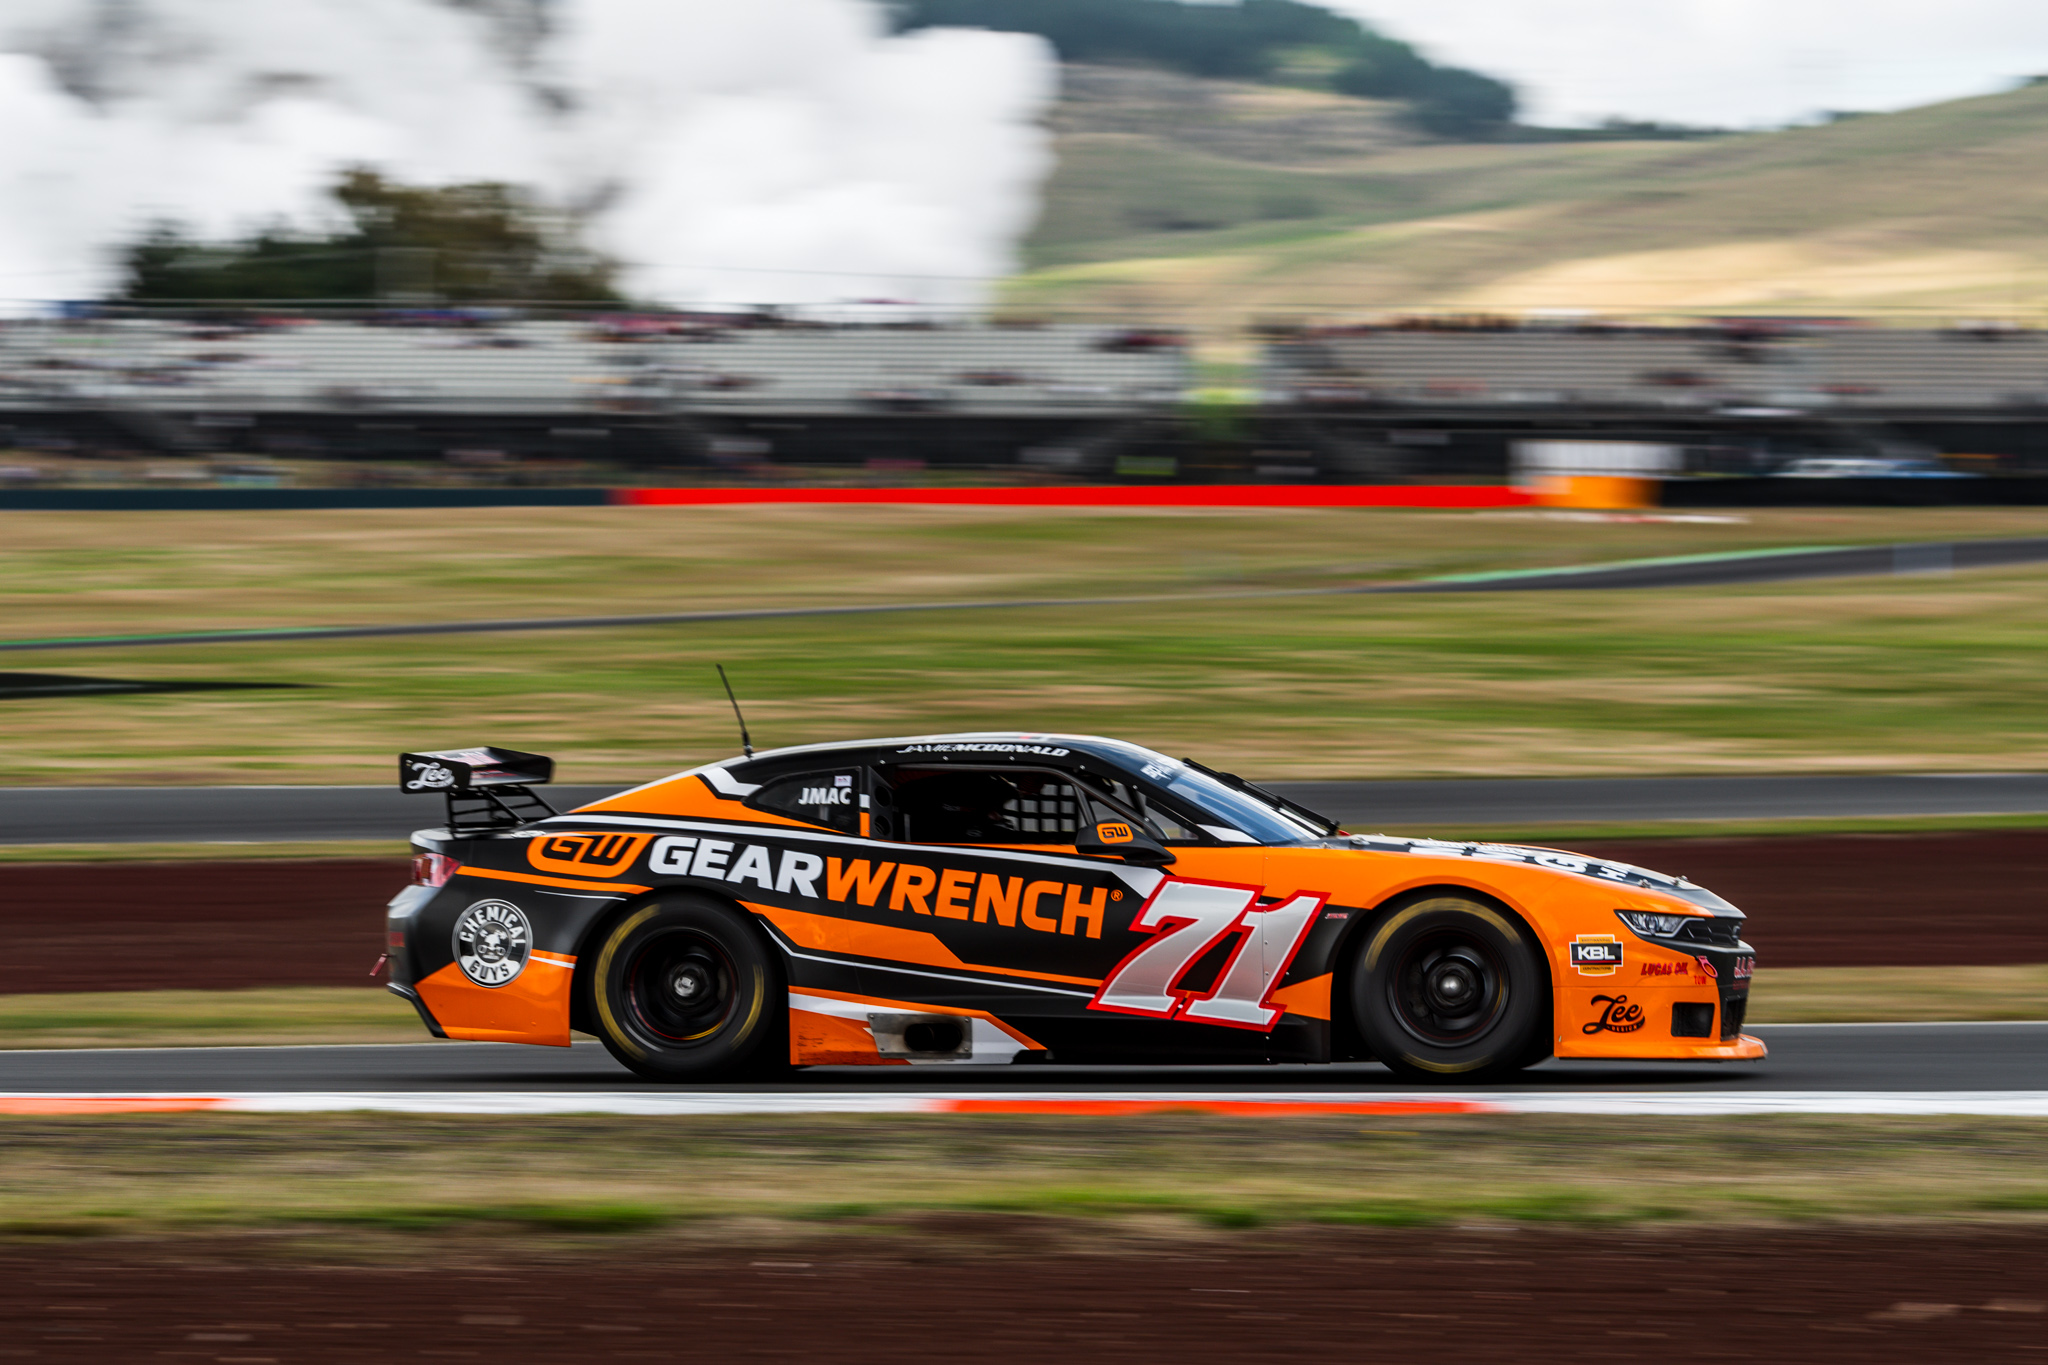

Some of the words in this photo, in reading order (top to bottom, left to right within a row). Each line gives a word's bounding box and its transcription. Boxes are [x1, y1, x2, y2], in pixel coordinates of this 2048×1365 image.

[798, 787, 852, 805] JMAC
[1086, 875, 1332, 1033] 71
[1577, 945, 1616, 961] KBL
[469, 959, 510, 981] GUYS
[1640, 962, 1673, 976] LUCAS
[1693, 975, 1707, 985] TOW
[1582, 993, 1646, 1035] Tee
